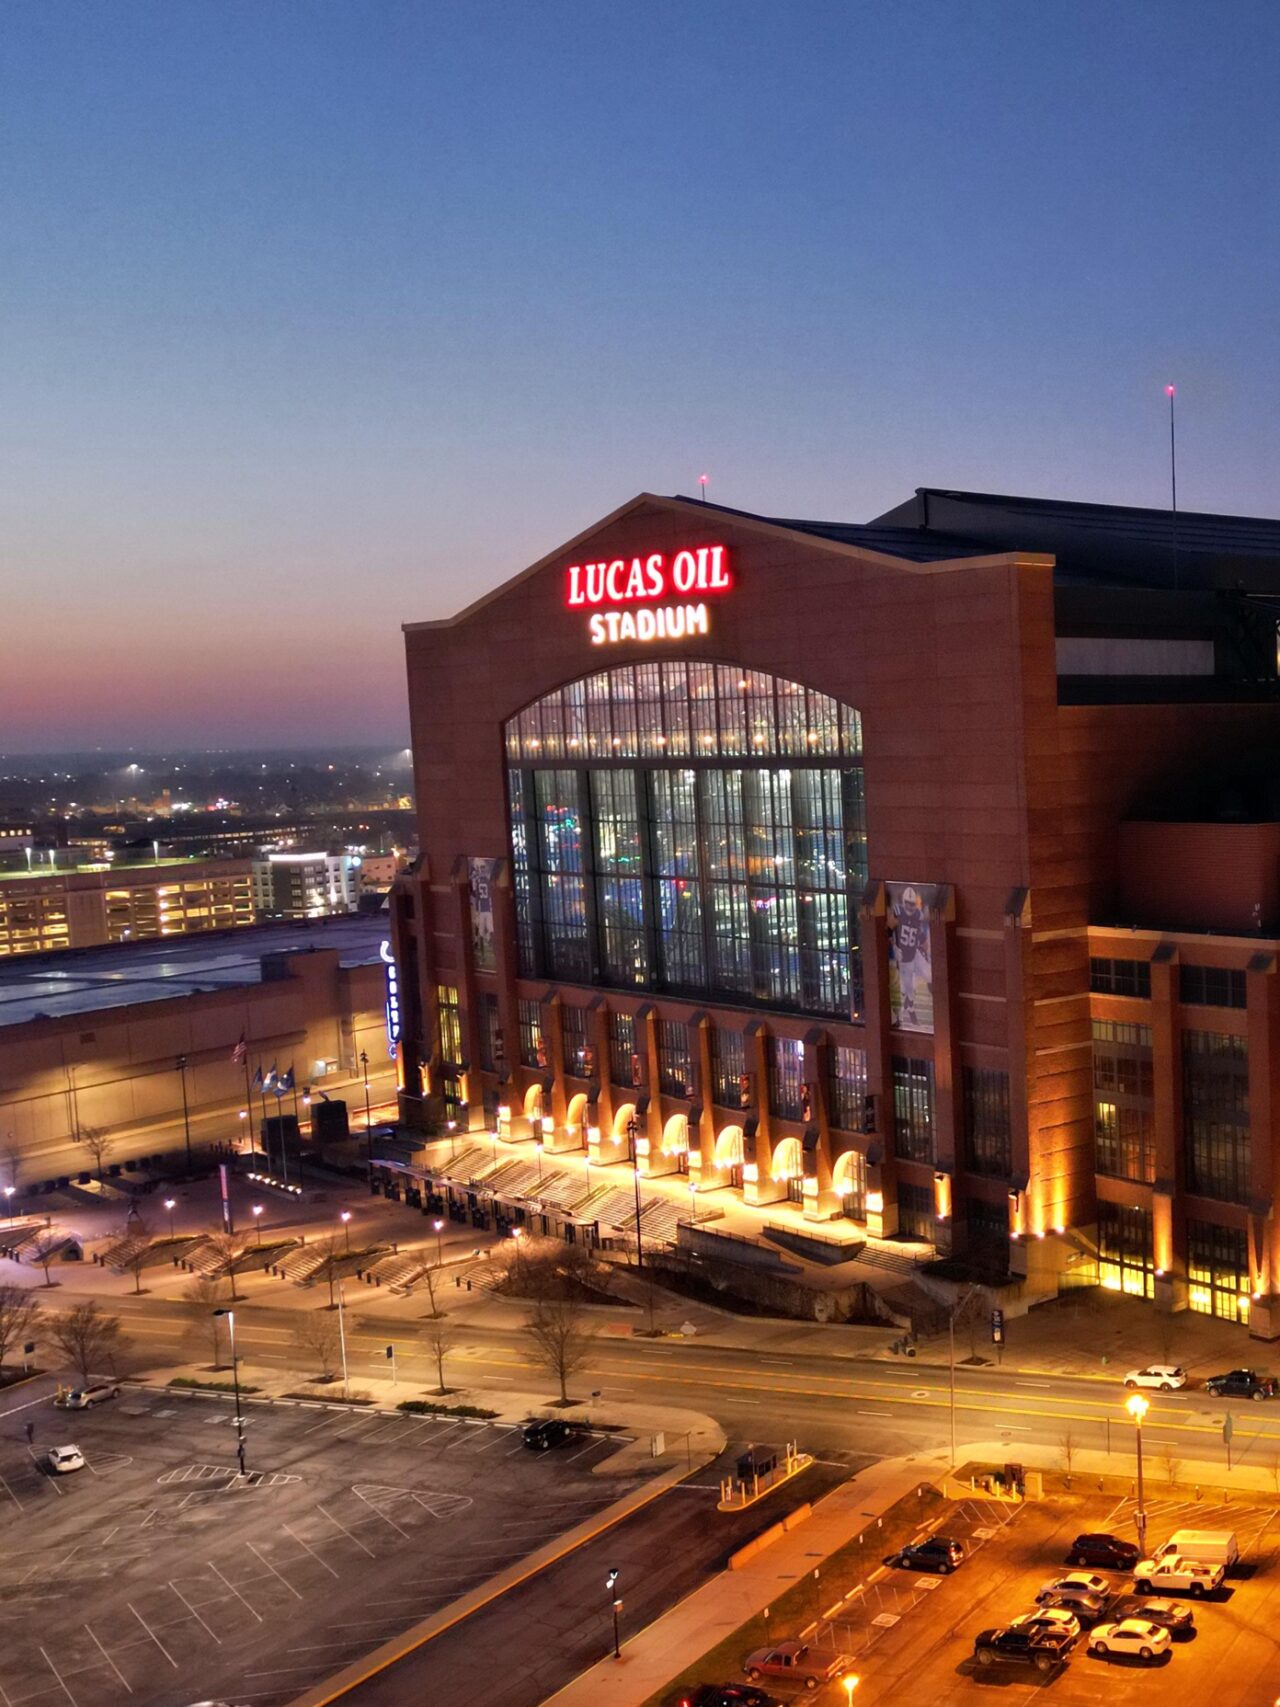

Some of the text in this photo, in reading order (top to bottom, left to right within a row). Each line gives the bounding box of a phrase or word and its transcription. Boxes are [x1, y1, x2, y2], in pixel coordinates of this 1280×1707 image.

[568, 546, 729, 605] LUCAS OIL
[590, 603, 708, 645] STADIUM
[900, 924, 917, 947] 56
